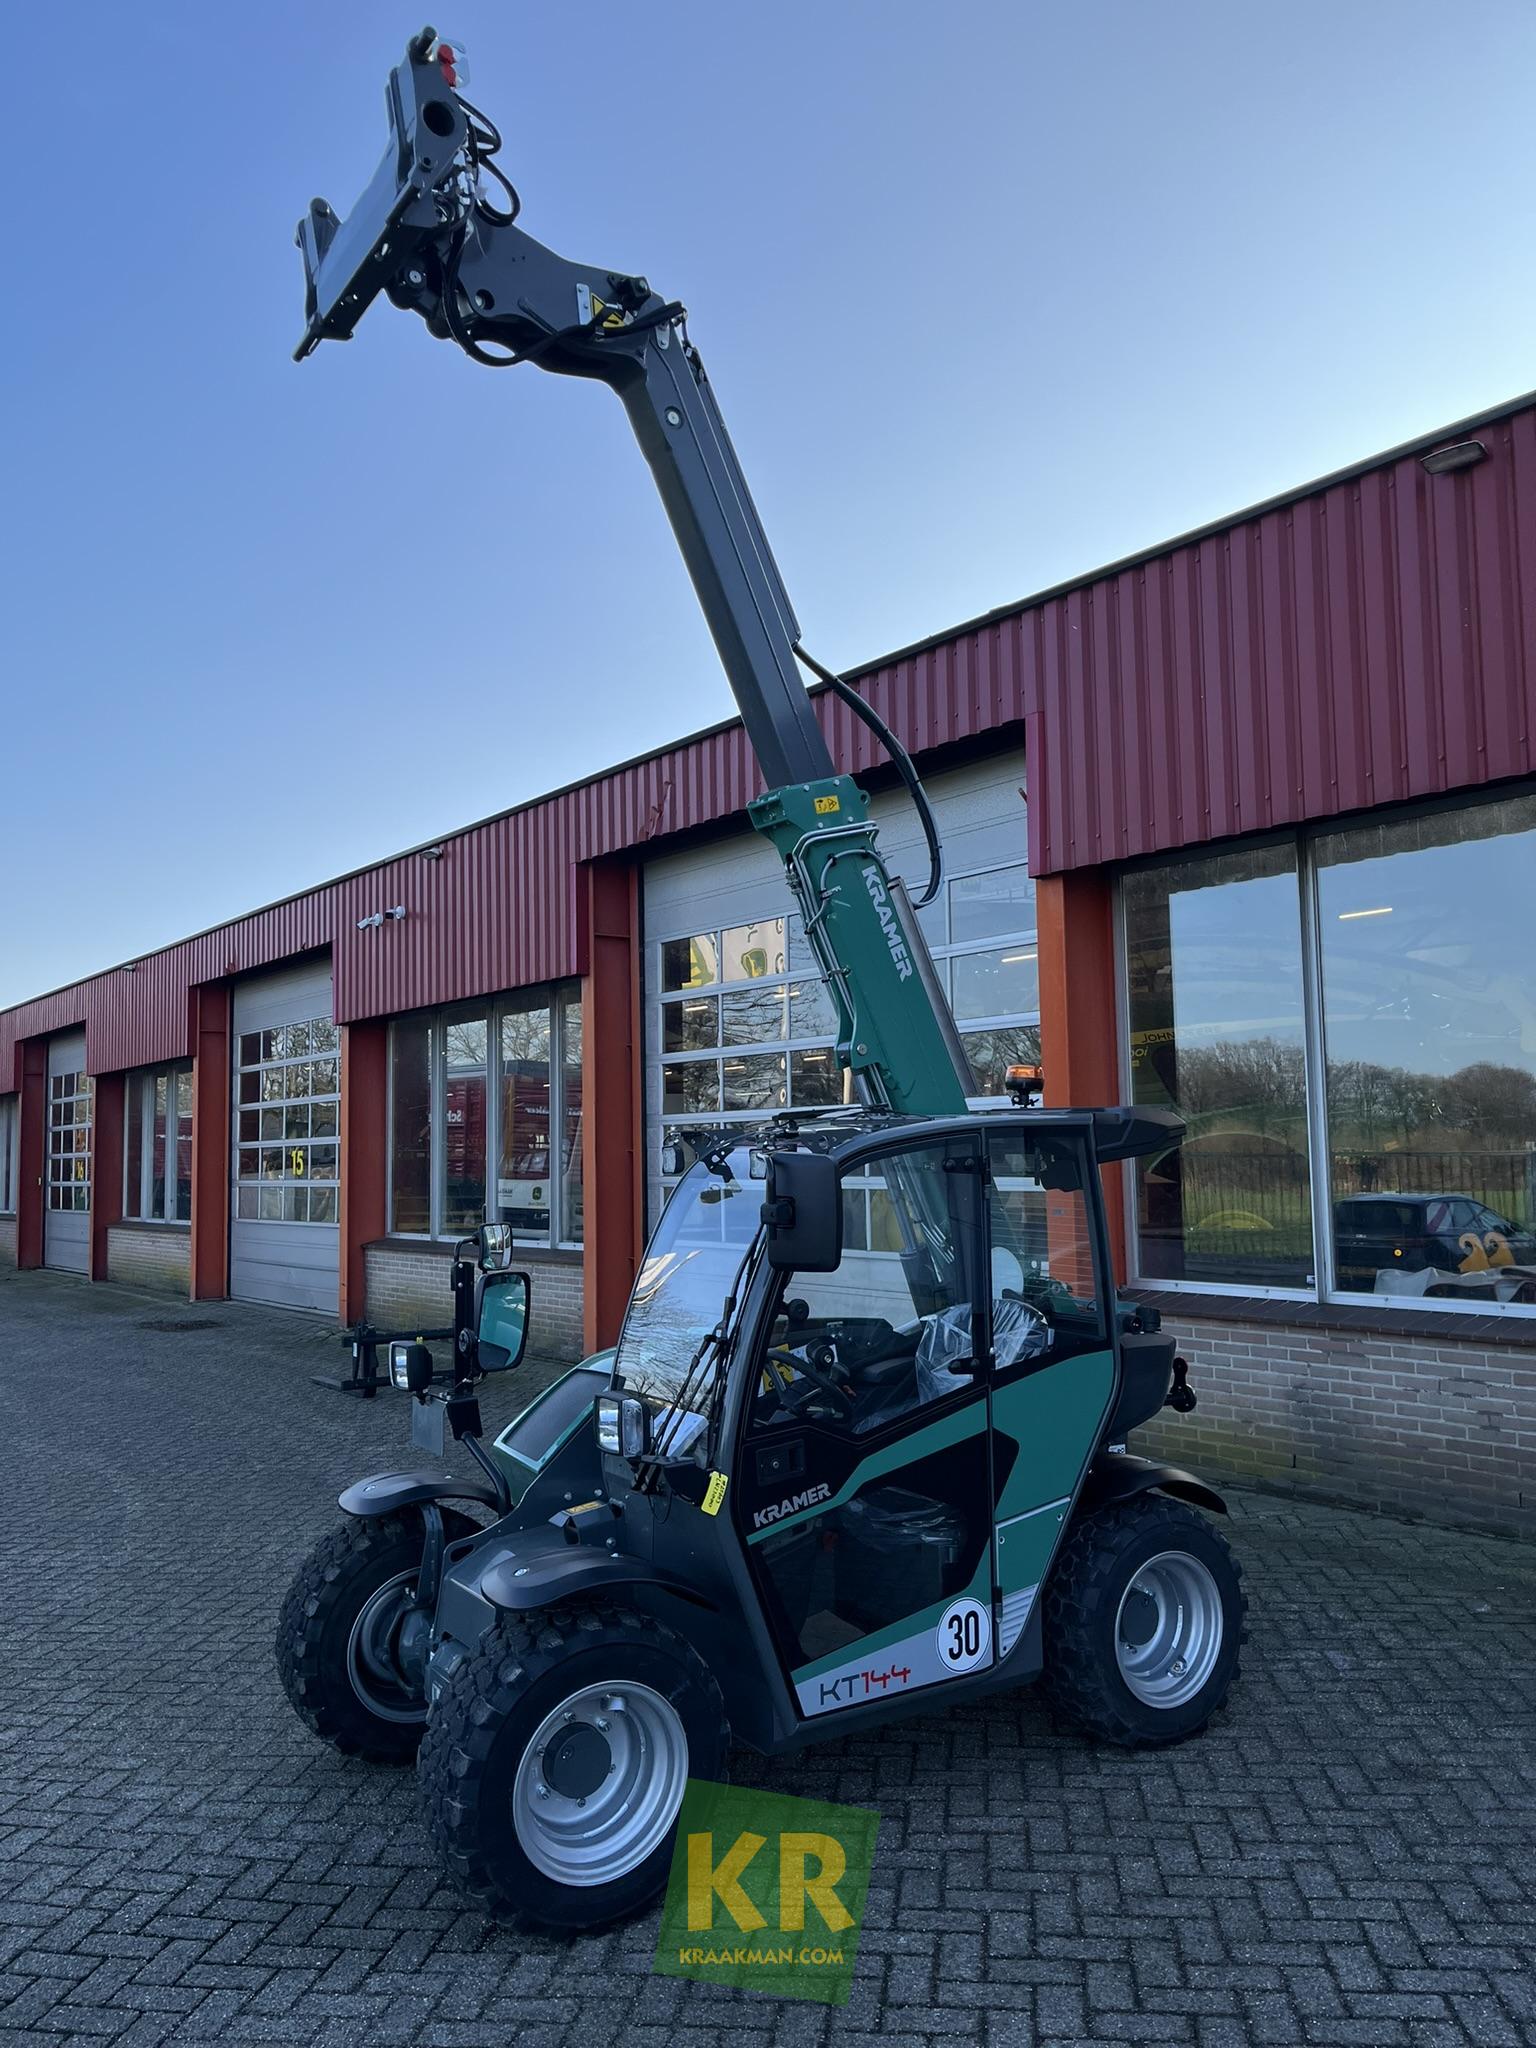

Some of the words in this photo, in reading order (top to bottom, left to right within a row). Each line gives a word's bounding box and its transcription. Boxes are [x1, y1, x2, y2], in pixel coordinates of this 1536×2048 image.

[862, 865, 913, 983] KRAMER
[1143, 1032, 1175, 1043] JOHN
[291, 1150, 304, 1176] 15
[753, 1482, 832, 1528] KRAMER
[948, 1610, 980, 1661] 30
[820, 1664, 911, 1706] KT144
